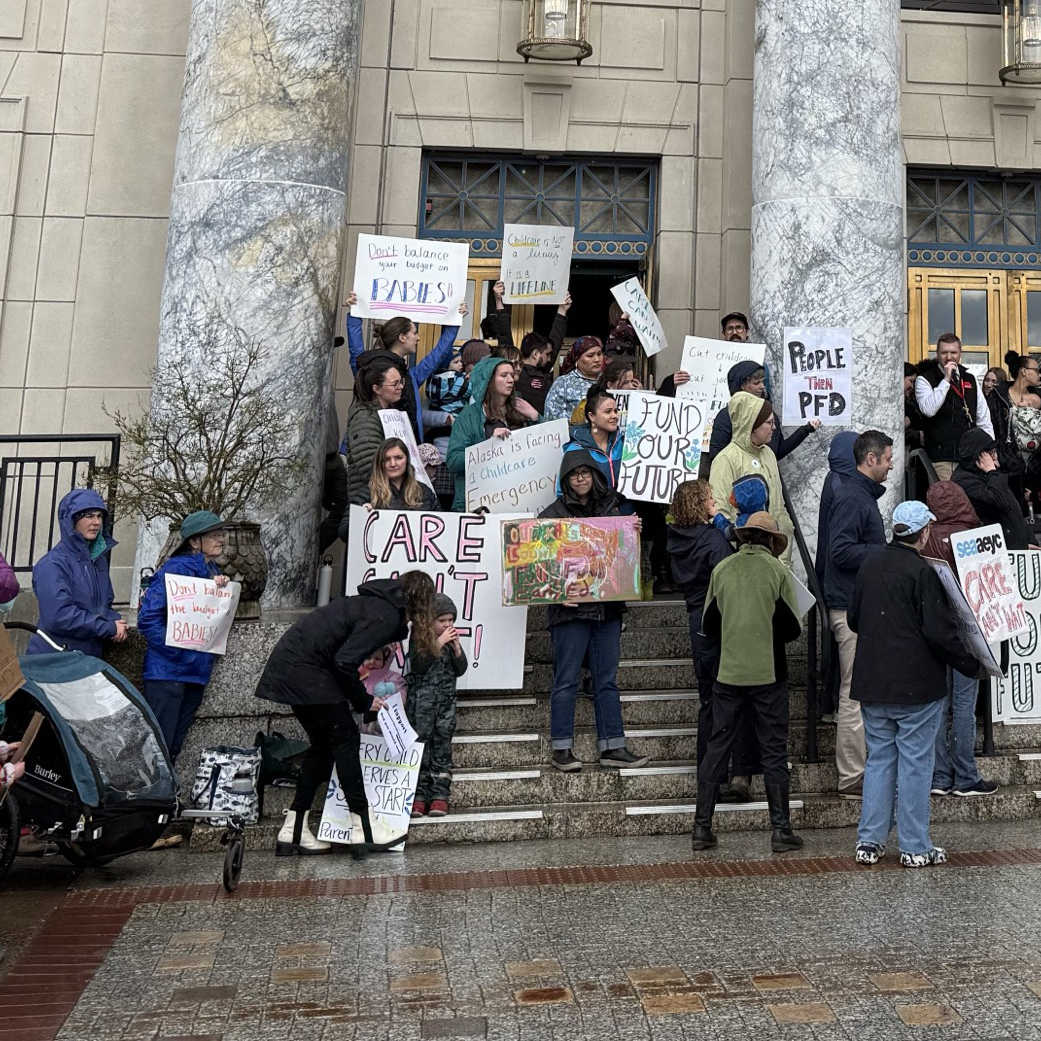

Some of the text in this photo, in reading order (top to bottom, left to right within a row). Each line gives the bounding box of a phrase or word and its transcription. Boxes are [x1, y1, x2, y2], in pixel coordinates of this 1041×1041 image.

[404, 244, 449, 260] balance
[379, 261, 397, 271] your
[406, 260, 434, 272] budget
[510, 280, 557, 295] LIFELINE
[689, 346, 709, 358] Cut
[788, 341, 846, 374] PEOPLE
[638, 396, 702, 436] FUND
[798, 391, 847, 419] PFD
[467, 432, 561, 469] Alaska is facing
[636, 433, 692, 470] OUR
[480, 456, 537, 480] Childcare
[467, 473, 558, 512] Emergency
[363, 510, 486, 564] CARE
[956, 533, 1003, 559] seaaeyc
[965, 561, 1013, 614] CARE
[171, 604, 186, 615] the
[1002, 602, 1027, 632] WAIT
[384, 747, 420, 768] CILD
[34, 764, 61, 783] Burley
[400, 770, 410, 788] A
[374, 785, 412, 813] START
